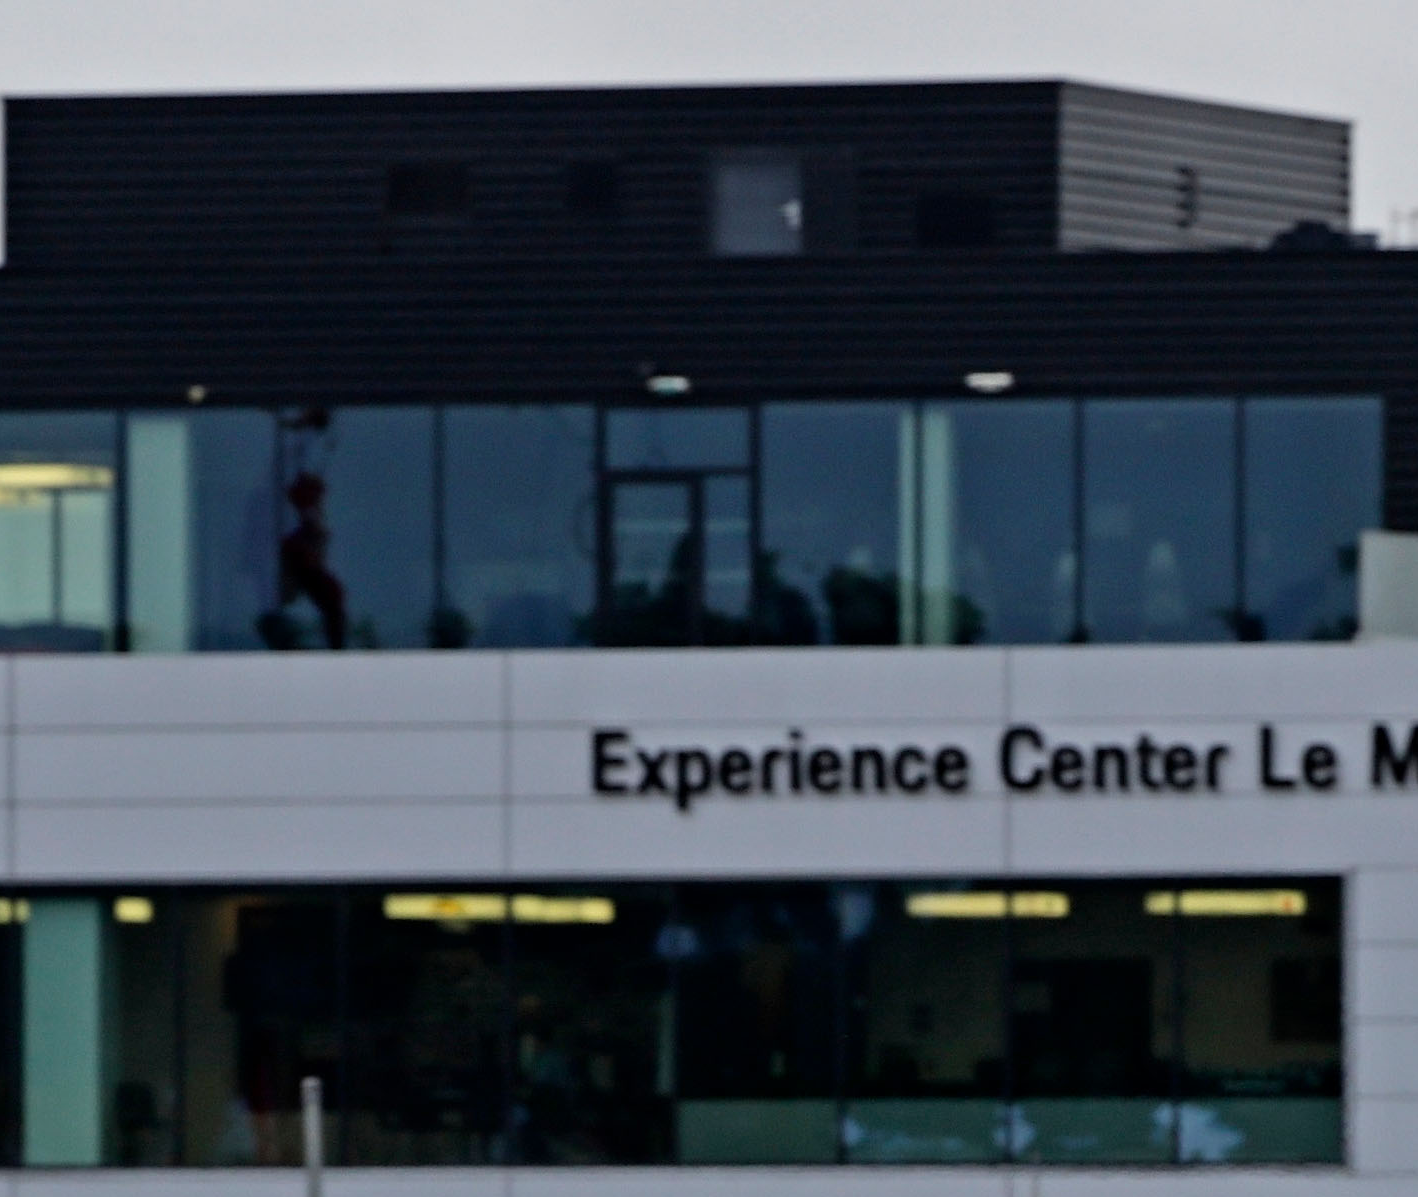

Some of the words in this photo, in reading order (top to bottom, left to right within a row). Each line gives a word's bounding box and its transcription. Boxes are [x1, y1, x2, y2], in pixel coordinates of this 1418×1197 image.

[591, 728, 973, 812] Experience
[999, 724, 1229, 793] Center
[1260, 722, 1339, 789] Le
